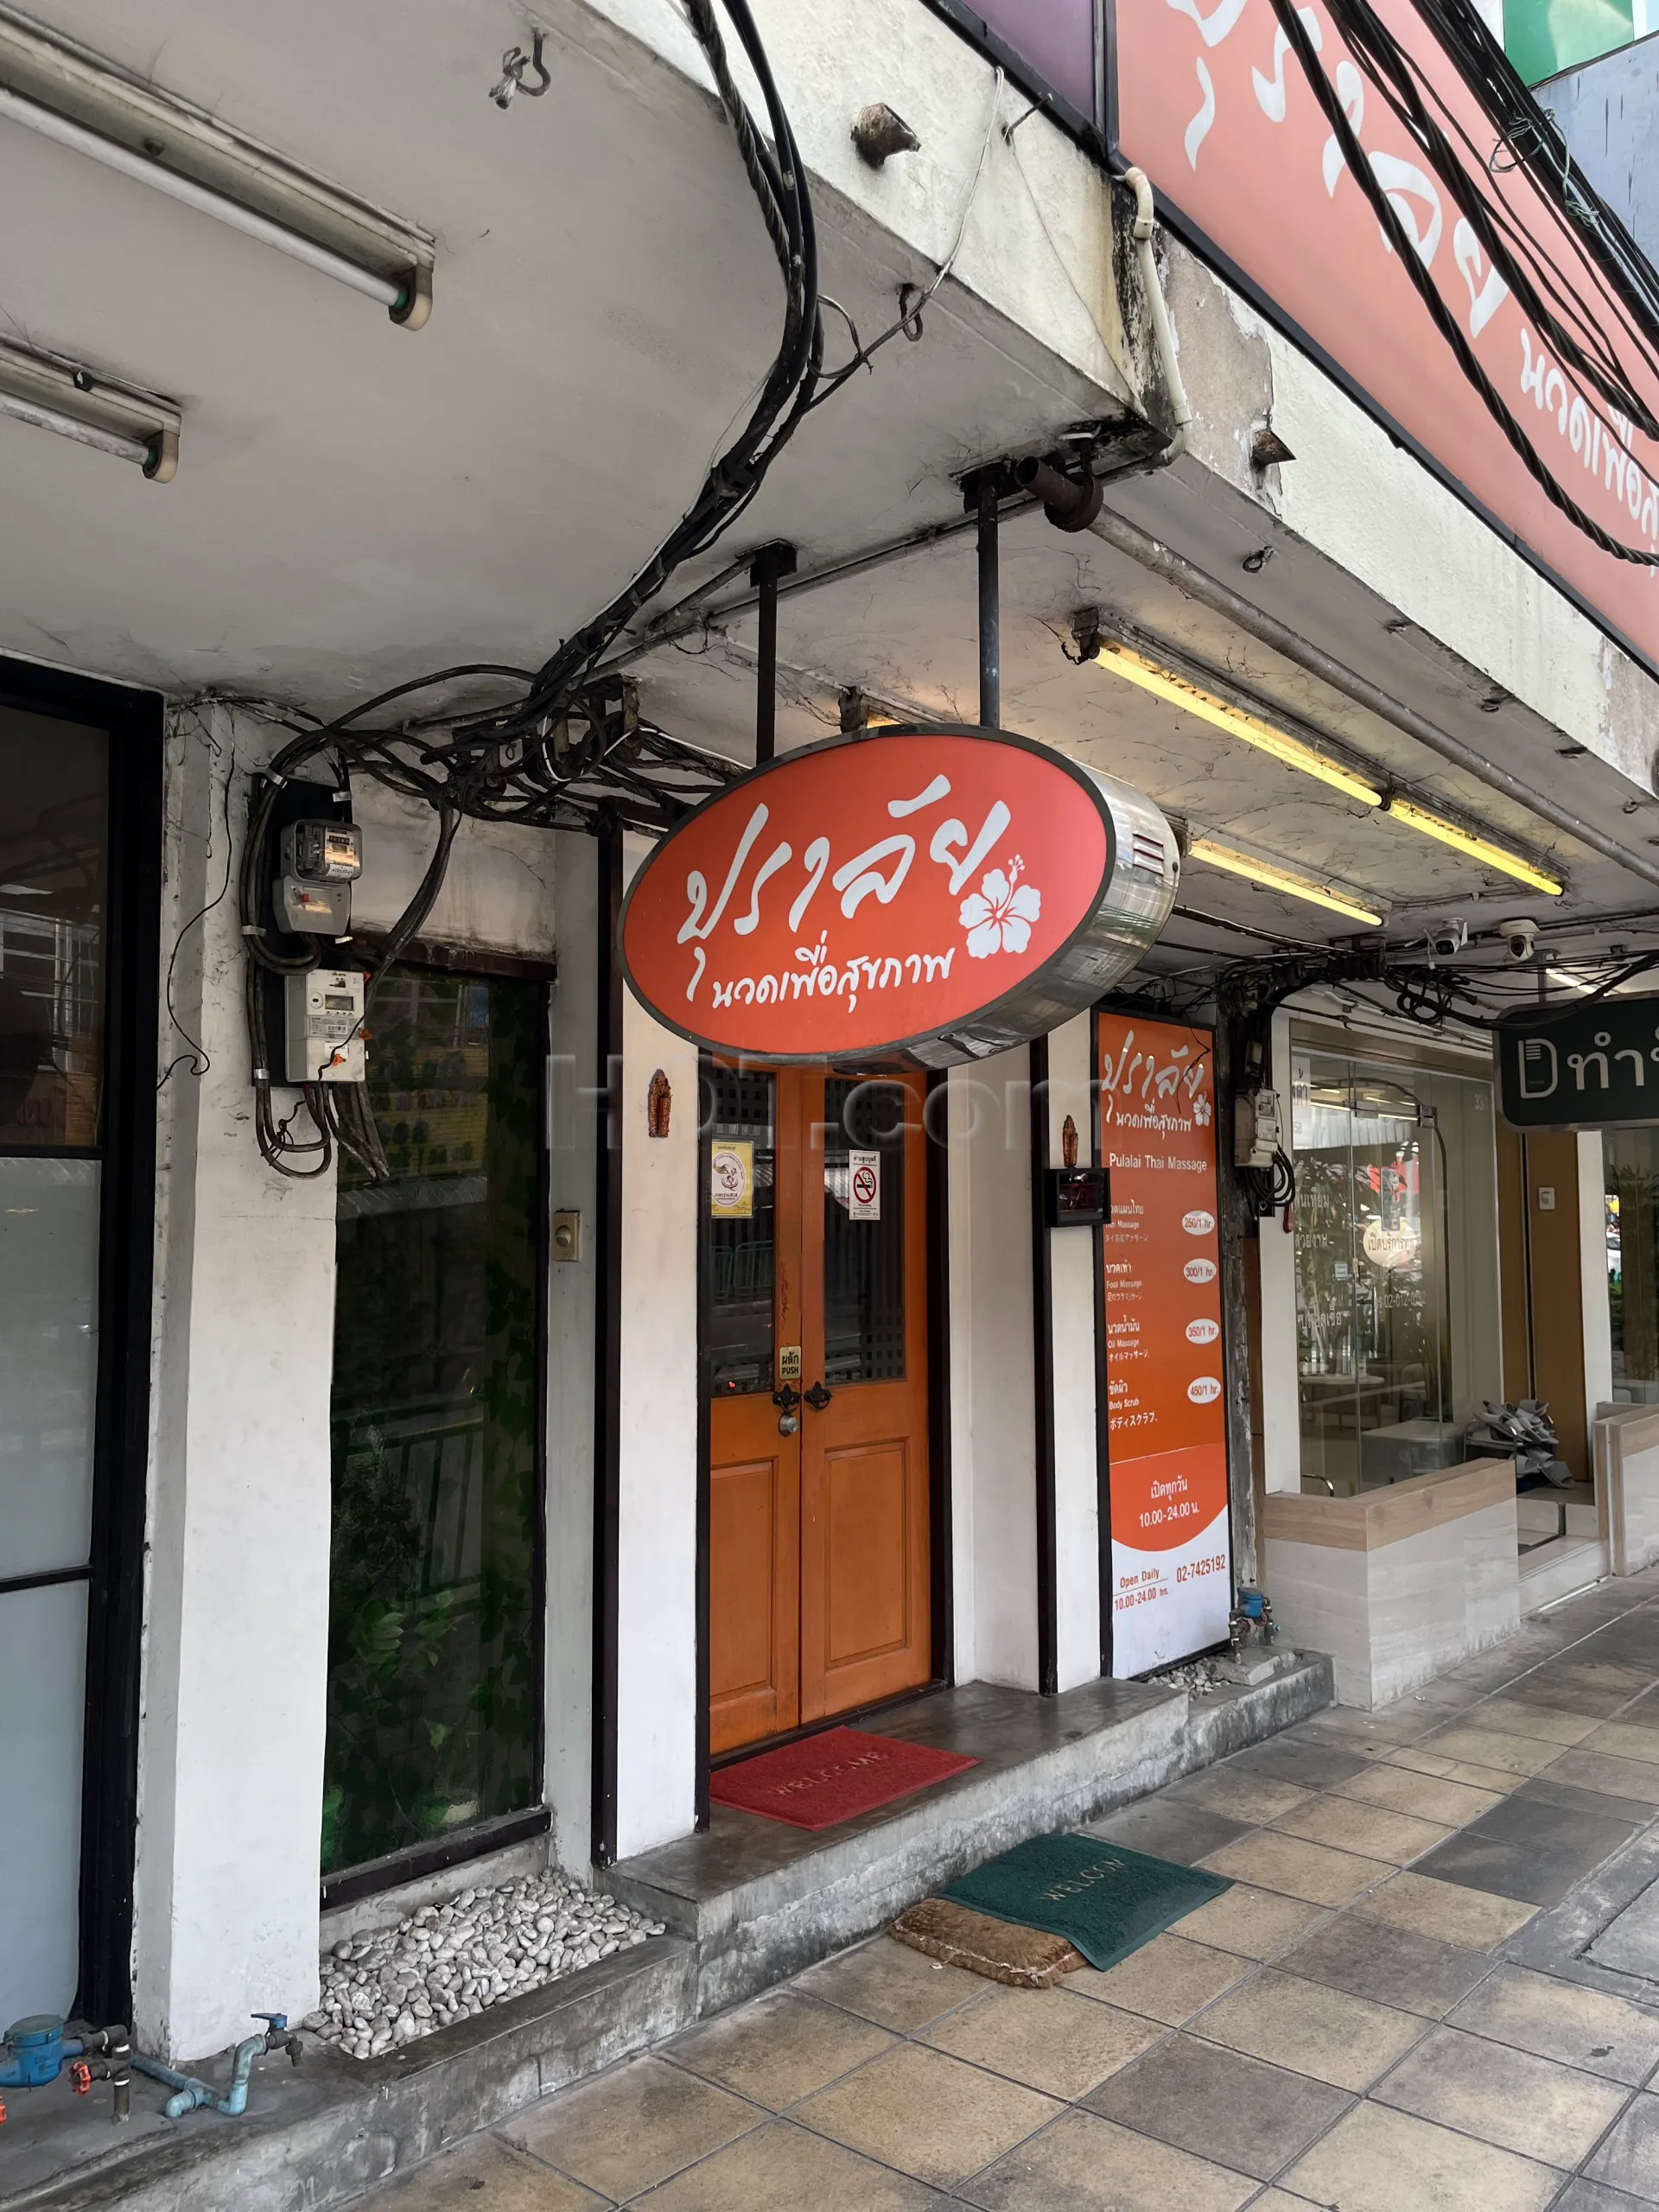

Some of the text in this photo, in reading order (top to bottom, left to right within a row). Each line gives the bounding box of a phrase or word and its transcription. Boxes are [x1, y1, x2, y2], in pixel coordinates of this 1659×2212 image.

[677, 774, 1011, 1002] ปุราลัย
[712, 930, 957, 1013] นวดเพื่อสุขภาพ
[1567, 1031, 1659, 1090] ทำ
[1116, 1097, 1192, 1140] นวดเพื่อสุขภาพ
[1109, 1153, 1207, 1173] Pulalai Thai Massage
[1185, 1217, 1202, 1229] 250/1
[1185, 1266, 1204, 1277] 300/1
[1106, 1280, 1119, 1289] Foot
[1188, 1325, 1206, 1338] 350/1
[1107, 1338, 1140, 1349] Oil Massage
[781, 1351, 799, 1365] ผลัก
[781, 1366, 799, 1375] PUSH
[1190, 1384, 1208, 1396] 450/1
[1109, 1396, 1140, 1410] Body Scrub
[1150, 1474, 1188, 1501] เปิดทุกวัน
[1176, 1554, 1226, 1583] 02-7425192
[1120, 1567, 1160, 1590] Open Daily
[1114, 1590, 1157, 1612] 10.00-24.00
